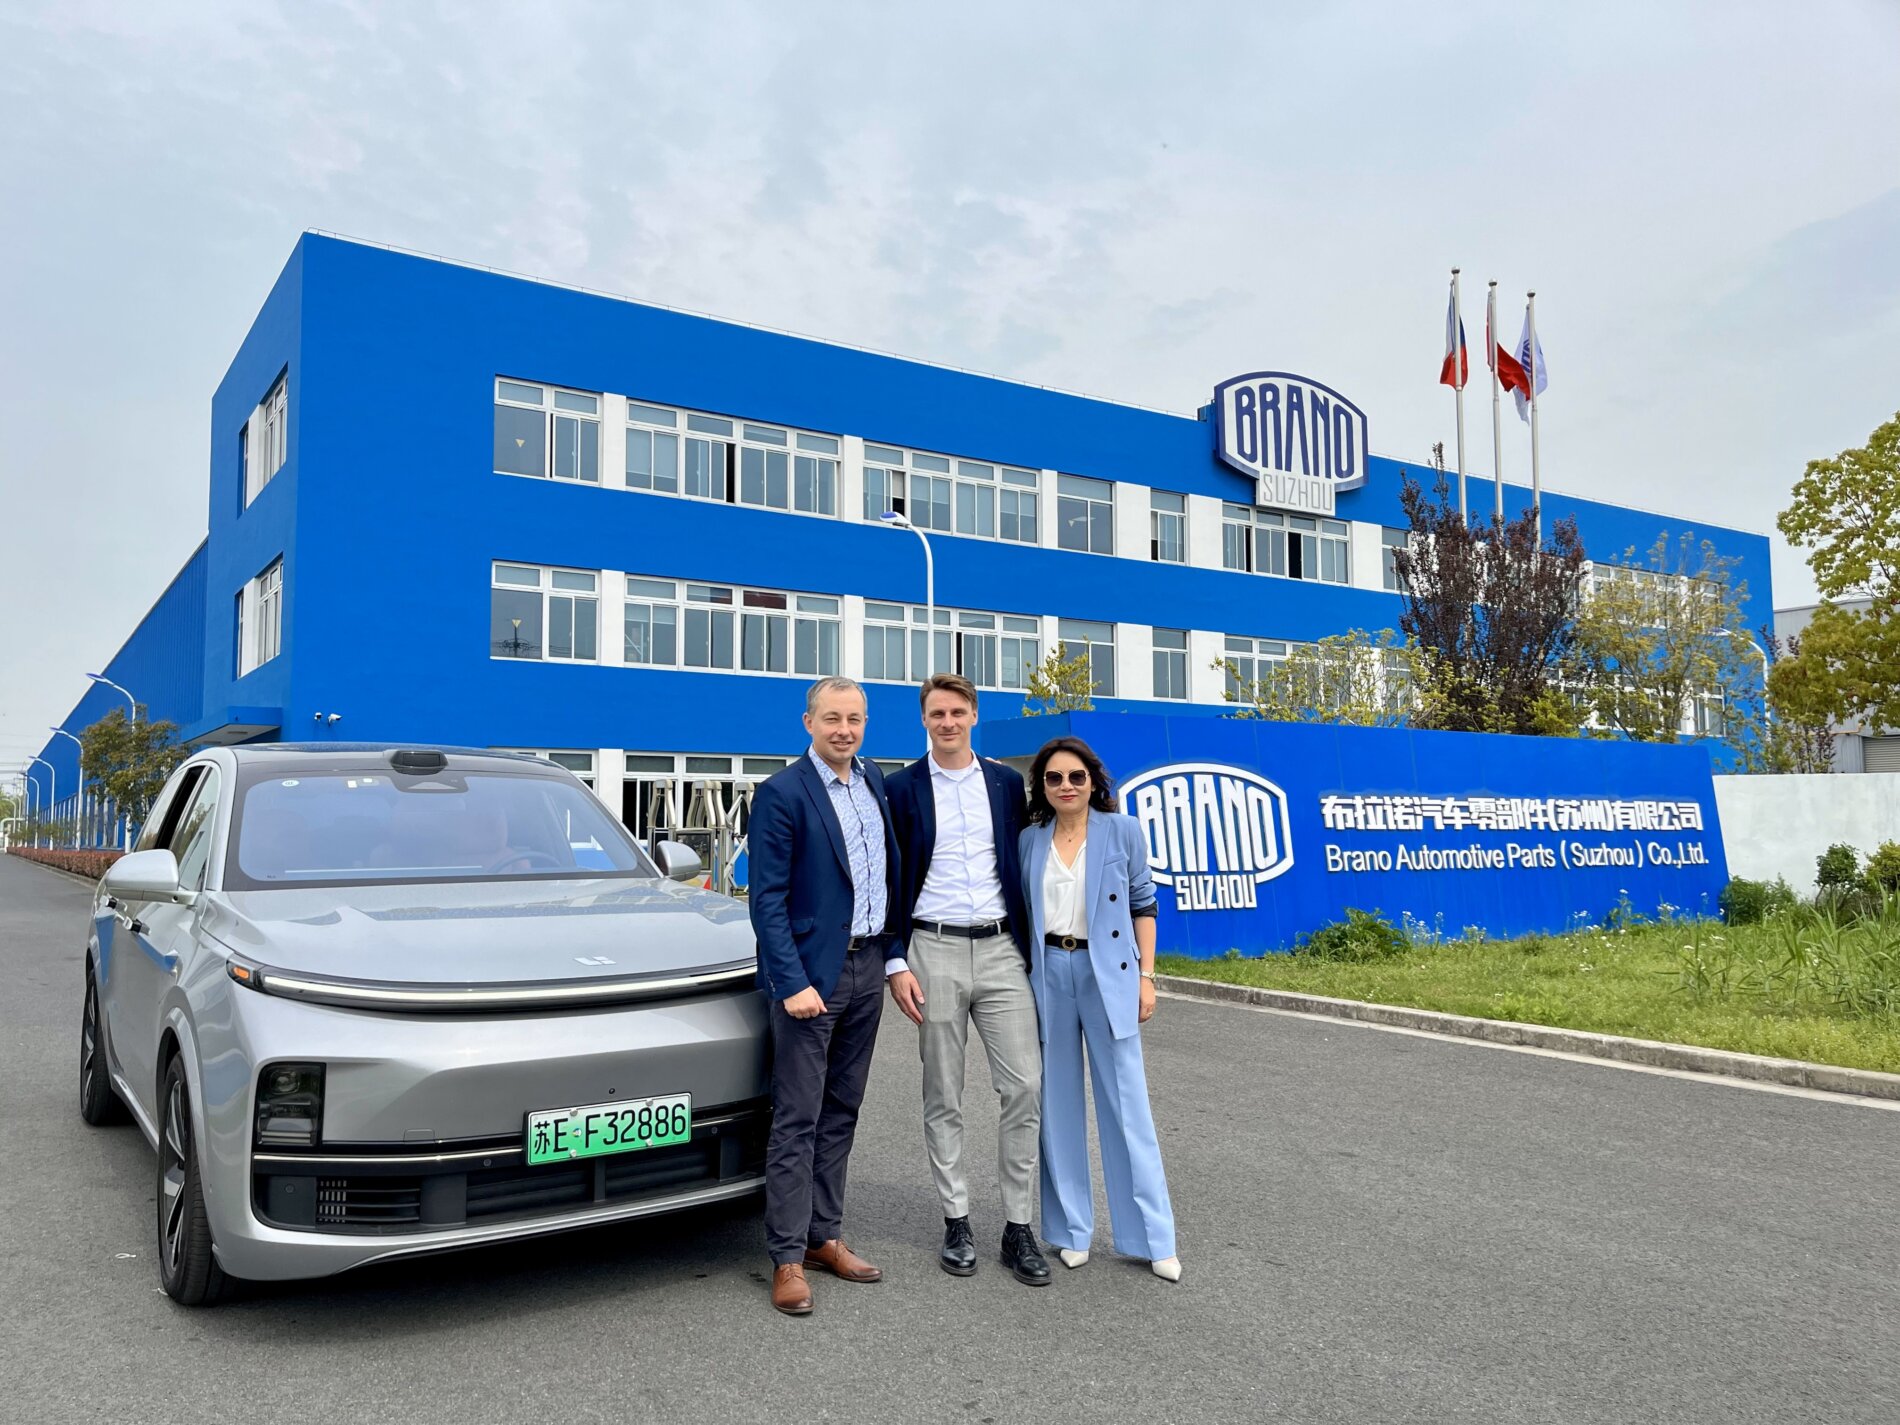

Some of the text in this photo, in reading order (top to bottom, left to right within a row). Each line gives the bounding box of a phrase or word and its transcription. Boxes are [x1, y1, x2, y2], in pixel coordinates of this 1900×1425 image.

[1234, 383, 1355, 479] BRANO
[1263, 473, 1334, 512] SUZHOU
[1135, 774, 1278, 872] BRANO
[1325, 844, 1392, 872] Brano
[1395, 843, 1505, 870] Automotive
[1506, 843, 1556, 868] Parts
[1647, 841, 1709, 869] Co.,Ltd.
[1175, 874, 1257, 911] SUZHOU
